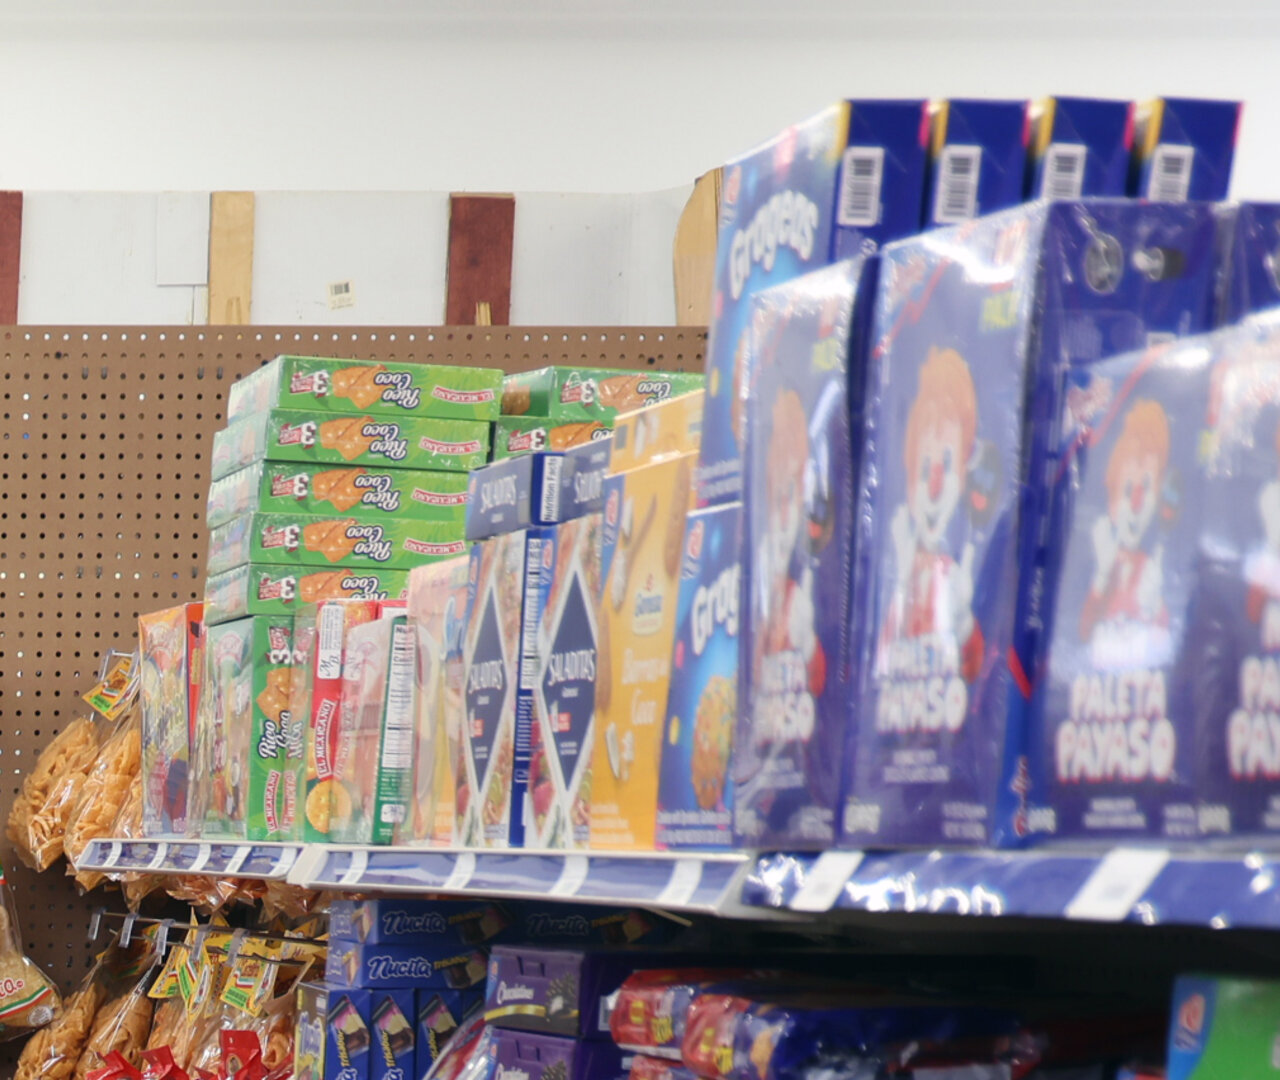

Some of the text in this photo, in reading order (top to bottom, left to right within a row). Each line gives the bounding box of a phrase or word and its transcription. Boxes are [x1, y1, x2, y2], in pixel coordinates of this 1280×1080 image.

[374, 372, 412, 390] Coco
[383, 388, 420, 409] Rico
[363, 424, 399, 441] Coco
[371, 439, 407, 460] Rico
[355, 476, 391, 493] Coco
[544, 456, 563, 523] Nutrition Facts
[363, 491, 400, 510] Rico
[346, 527, 383, 544] Coco
[342, 577, 378, 595] Coco
[548, 649, 595, 687] SALADITAS
[1071, 671, 1165, 719] PALETA
[258, 720, 277, 758] Rico
[316, 701, 332, 760] MEXICANO
[1057, 719, 1176, 782] PAYASO
[383, 910, 446, 936] Nucita
[368, 956, 432, 979] Nucita
